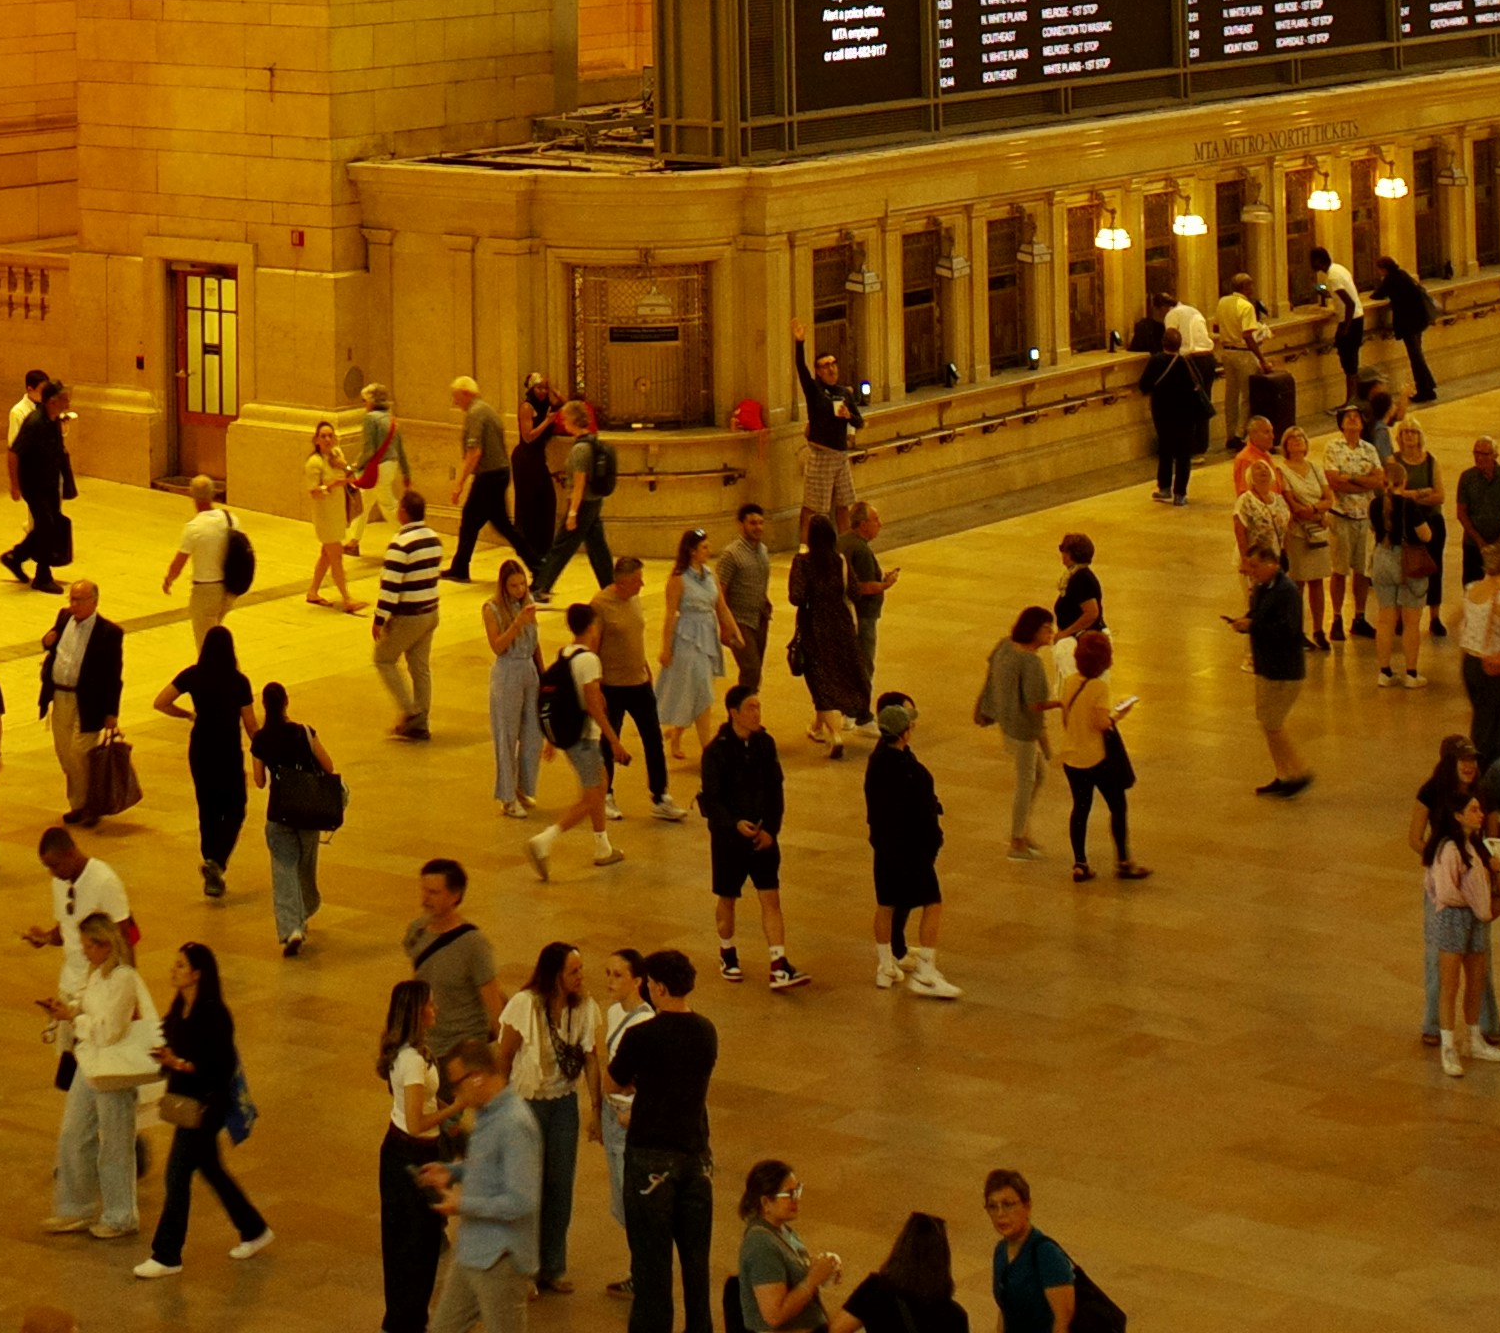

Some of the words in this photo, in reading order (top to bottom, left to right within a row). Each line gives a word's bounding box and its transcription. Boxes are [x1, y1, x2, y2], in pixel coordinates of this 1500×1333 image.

[1193, 141, 1220, 162] MTA
[1222, 125, 1311, 158] METRO-NORTH
[1313, 118, 1360, 143] TICKETS
